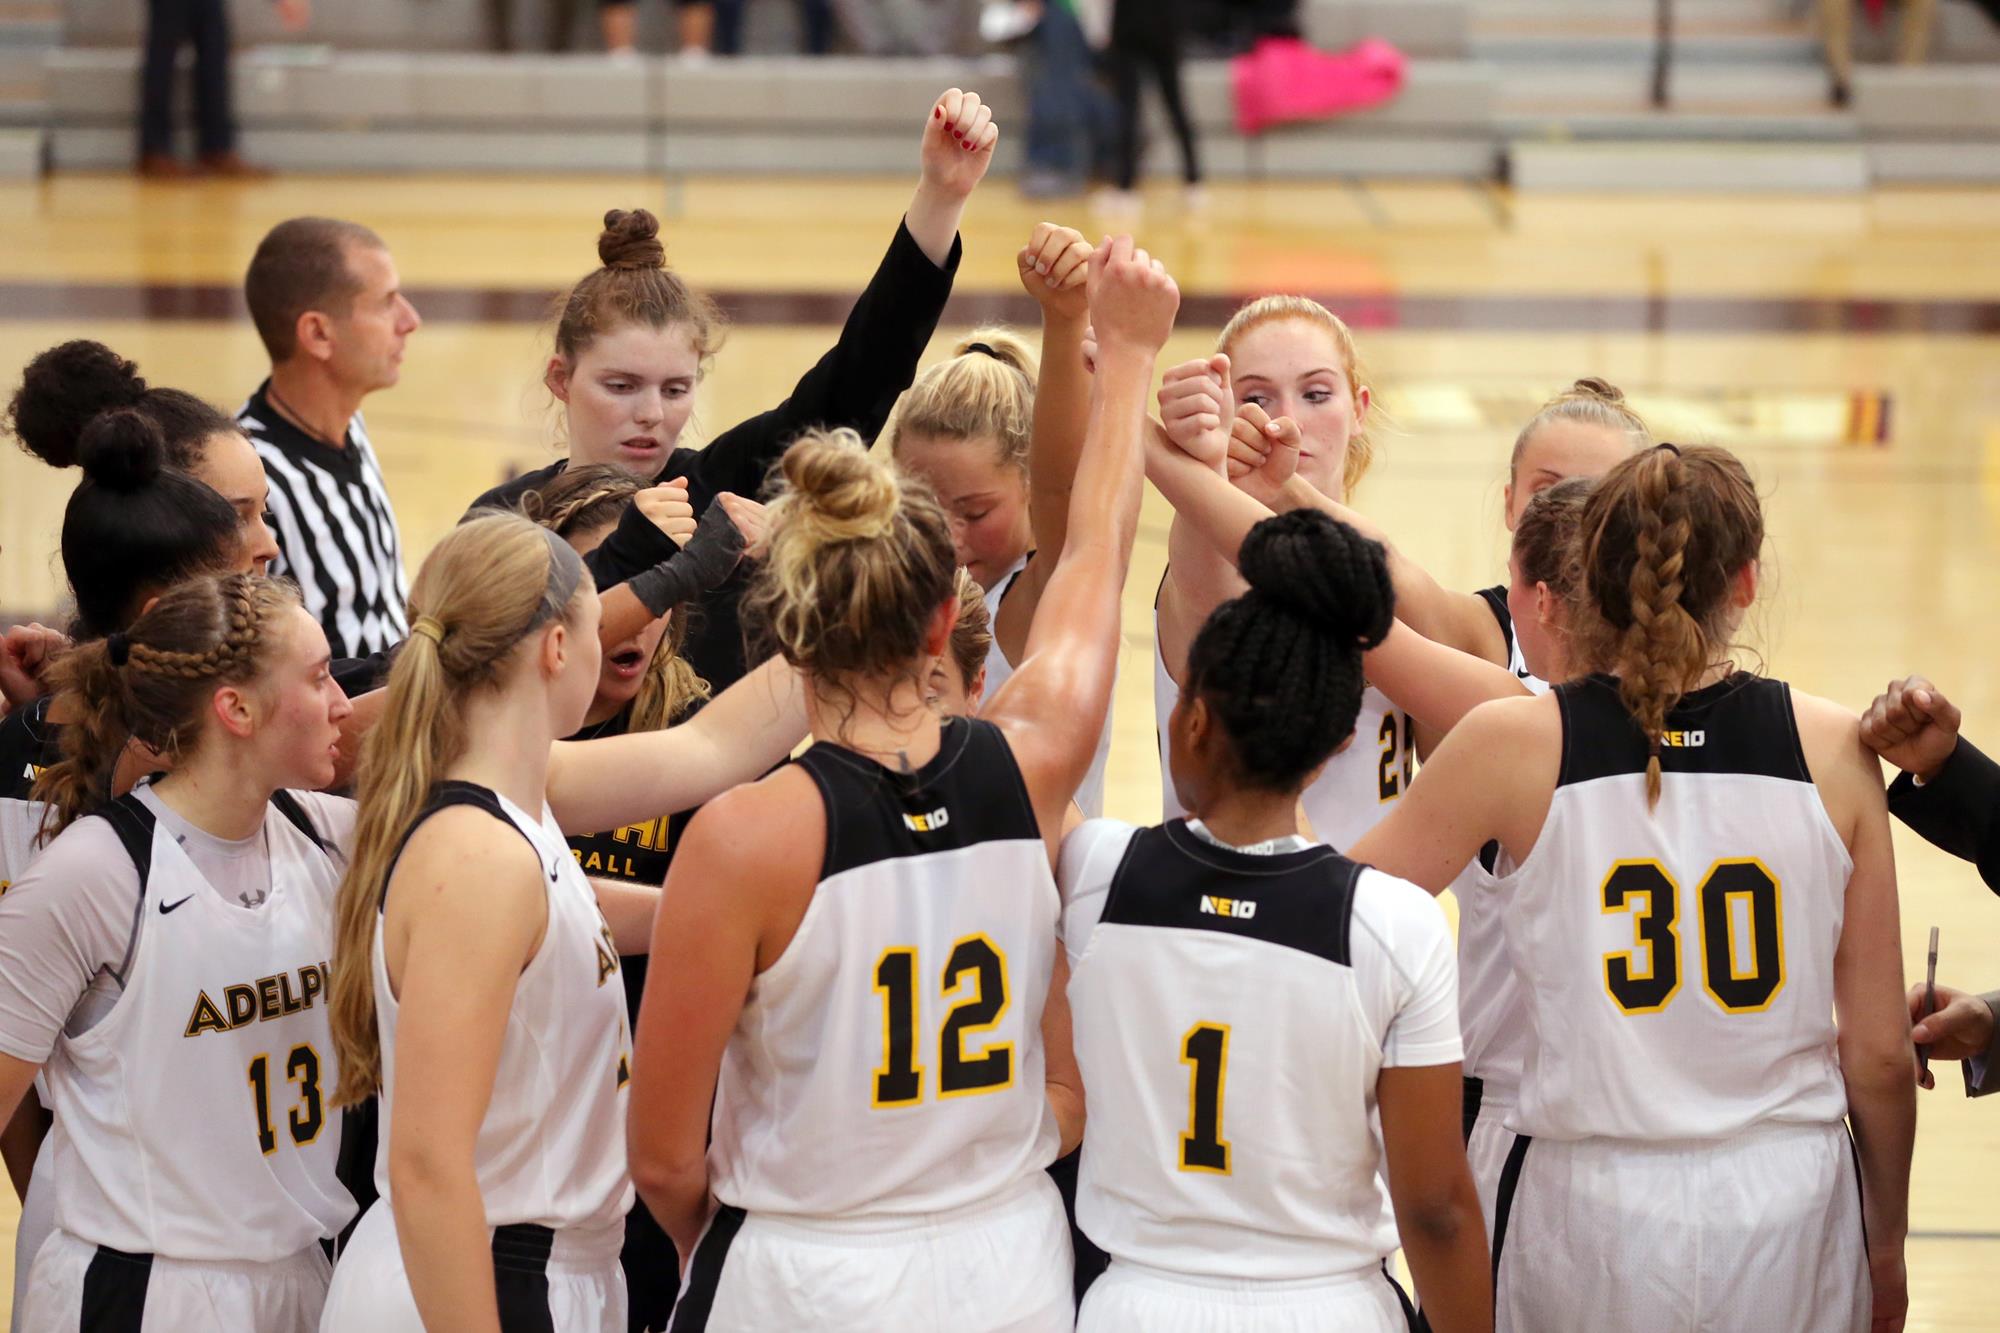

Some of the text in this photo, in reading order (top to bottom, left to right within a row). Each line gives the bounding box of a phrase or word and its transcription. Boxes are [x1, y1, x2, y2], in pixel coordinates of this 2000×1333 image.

[902, 806, 949, 831] NE10
[1200, 895, 1257, 919] NE10
[1599, 856, 1787, 1017] 30
[870, 930, 1016, 1110] 12
[248, 1042, 326, 1157] 13
[1178, 1020, 1233, 1176] 1
